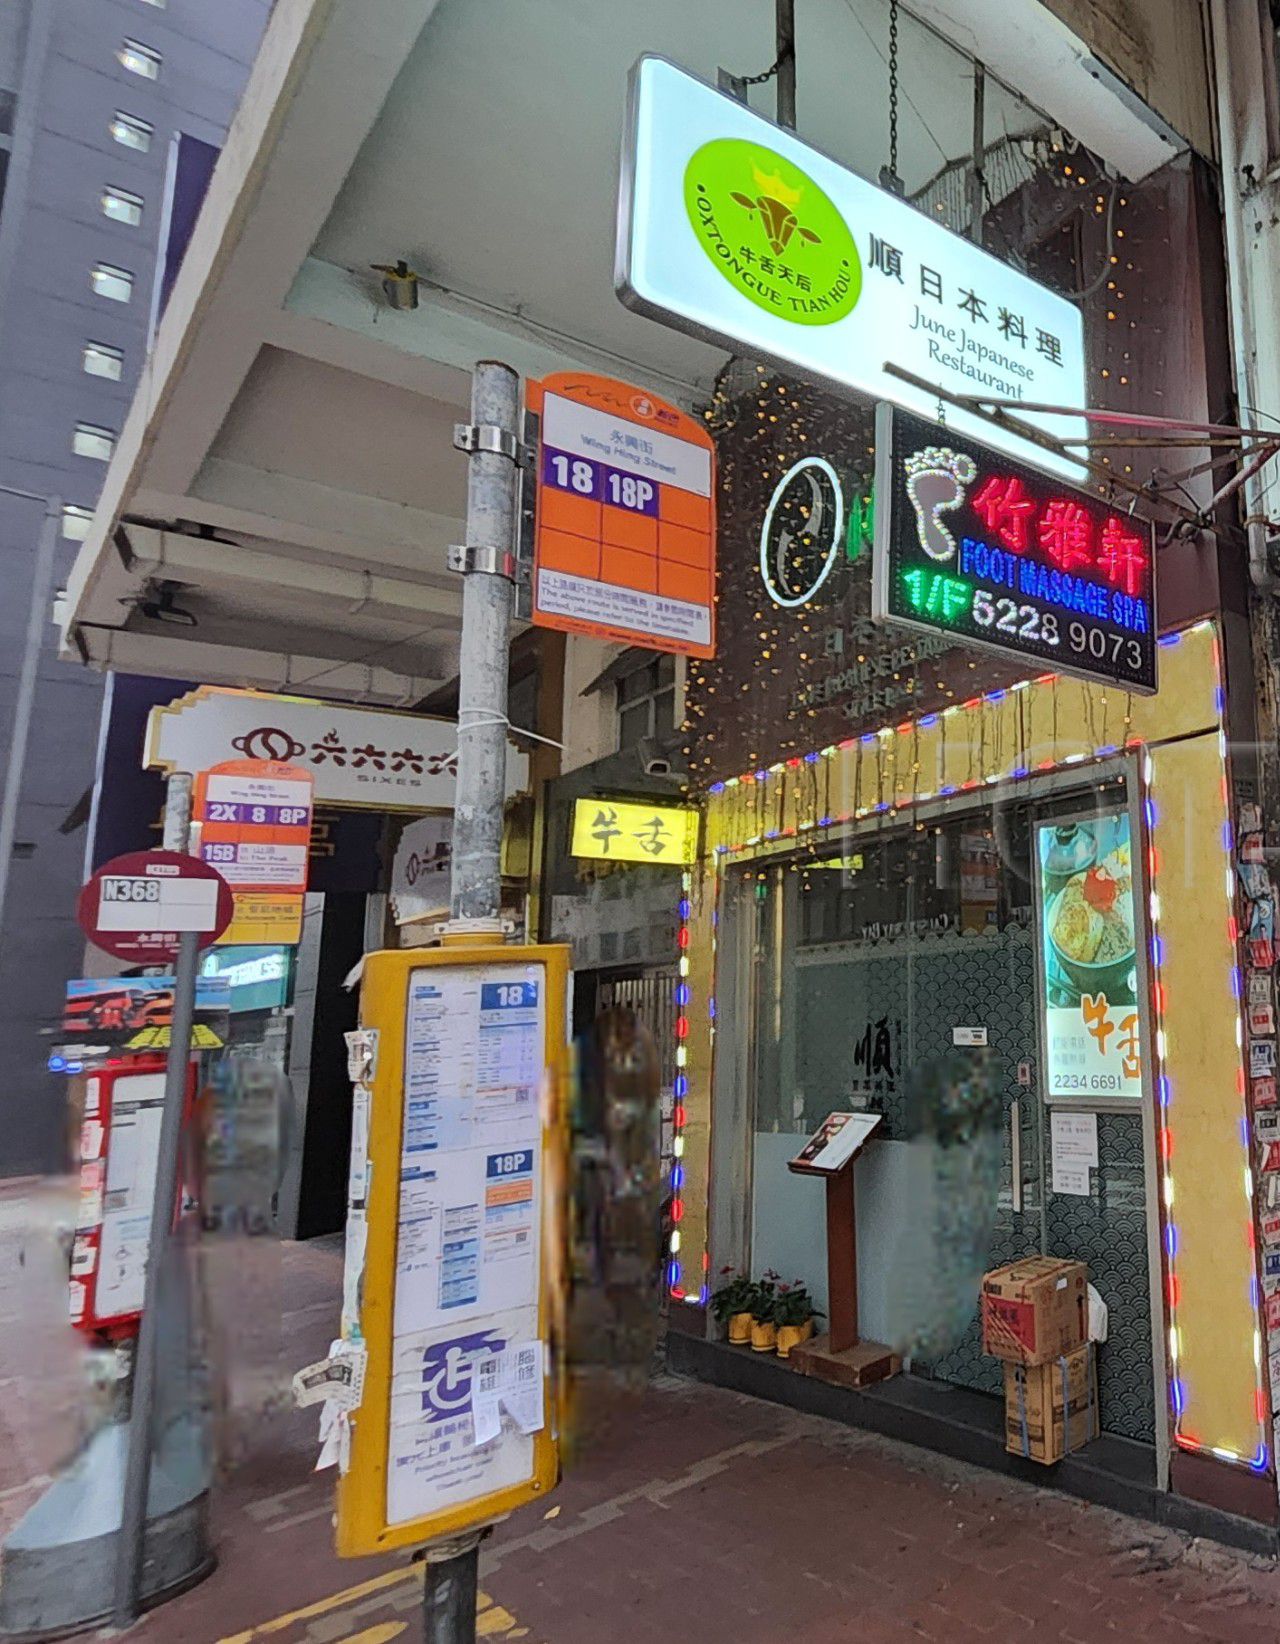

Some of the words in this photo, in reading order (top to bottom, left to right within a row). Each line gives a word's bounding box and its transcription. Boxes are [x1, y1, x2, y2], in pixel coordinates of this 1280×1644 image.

[740, 245, 812, 292] 牛舌天后
[788, 296, 831, 312] TIAN
[829, 269, 851, 303] HOU
[909, 305, 956, 342] June
[957, 329, 1034, 381] Japanese
[928, 339, 1023, 400] Restaurant
[580, 434, 610, 455] Wing
[614, 447, 640, 465] Hing
[644, 455, 676, 475] Street
[552, 456, 593, 493] 18
[609, 474, 653, 510] 18P
[972, 477, 1147, 595] 竹雅軒
[962, 537, 1018, 588] FOOT
[1020, 558, 1109, 620] MASSAGE
[1112, 591, 1147, 633] SPA
[904, 569, 967, 617] 1/F
[972, 589, 1060, 645] 5228
[1069, 621, 1142, 669] 9073
[357, 774, 421, 787] SIXES
[209, 804, 236, 821] 2X
[252, 807, 266, 823] 8
[280, 808, 306, 825] 8P
[591, 807, 672, 856] 牛舌
[204, 844, 234, 861] 15B
[105, 880, 159, 901] N368
[497, 986, 523, 1006] 18
[854, 1015, 894, 1079] 順
[1083, 992, 1140, 1079] 牛舌
[1055, 1074, 1087, 1089] 2234
[1091, 1074, 1121, 1090] 6691
[494, 1152, 525, 1175] 18P
